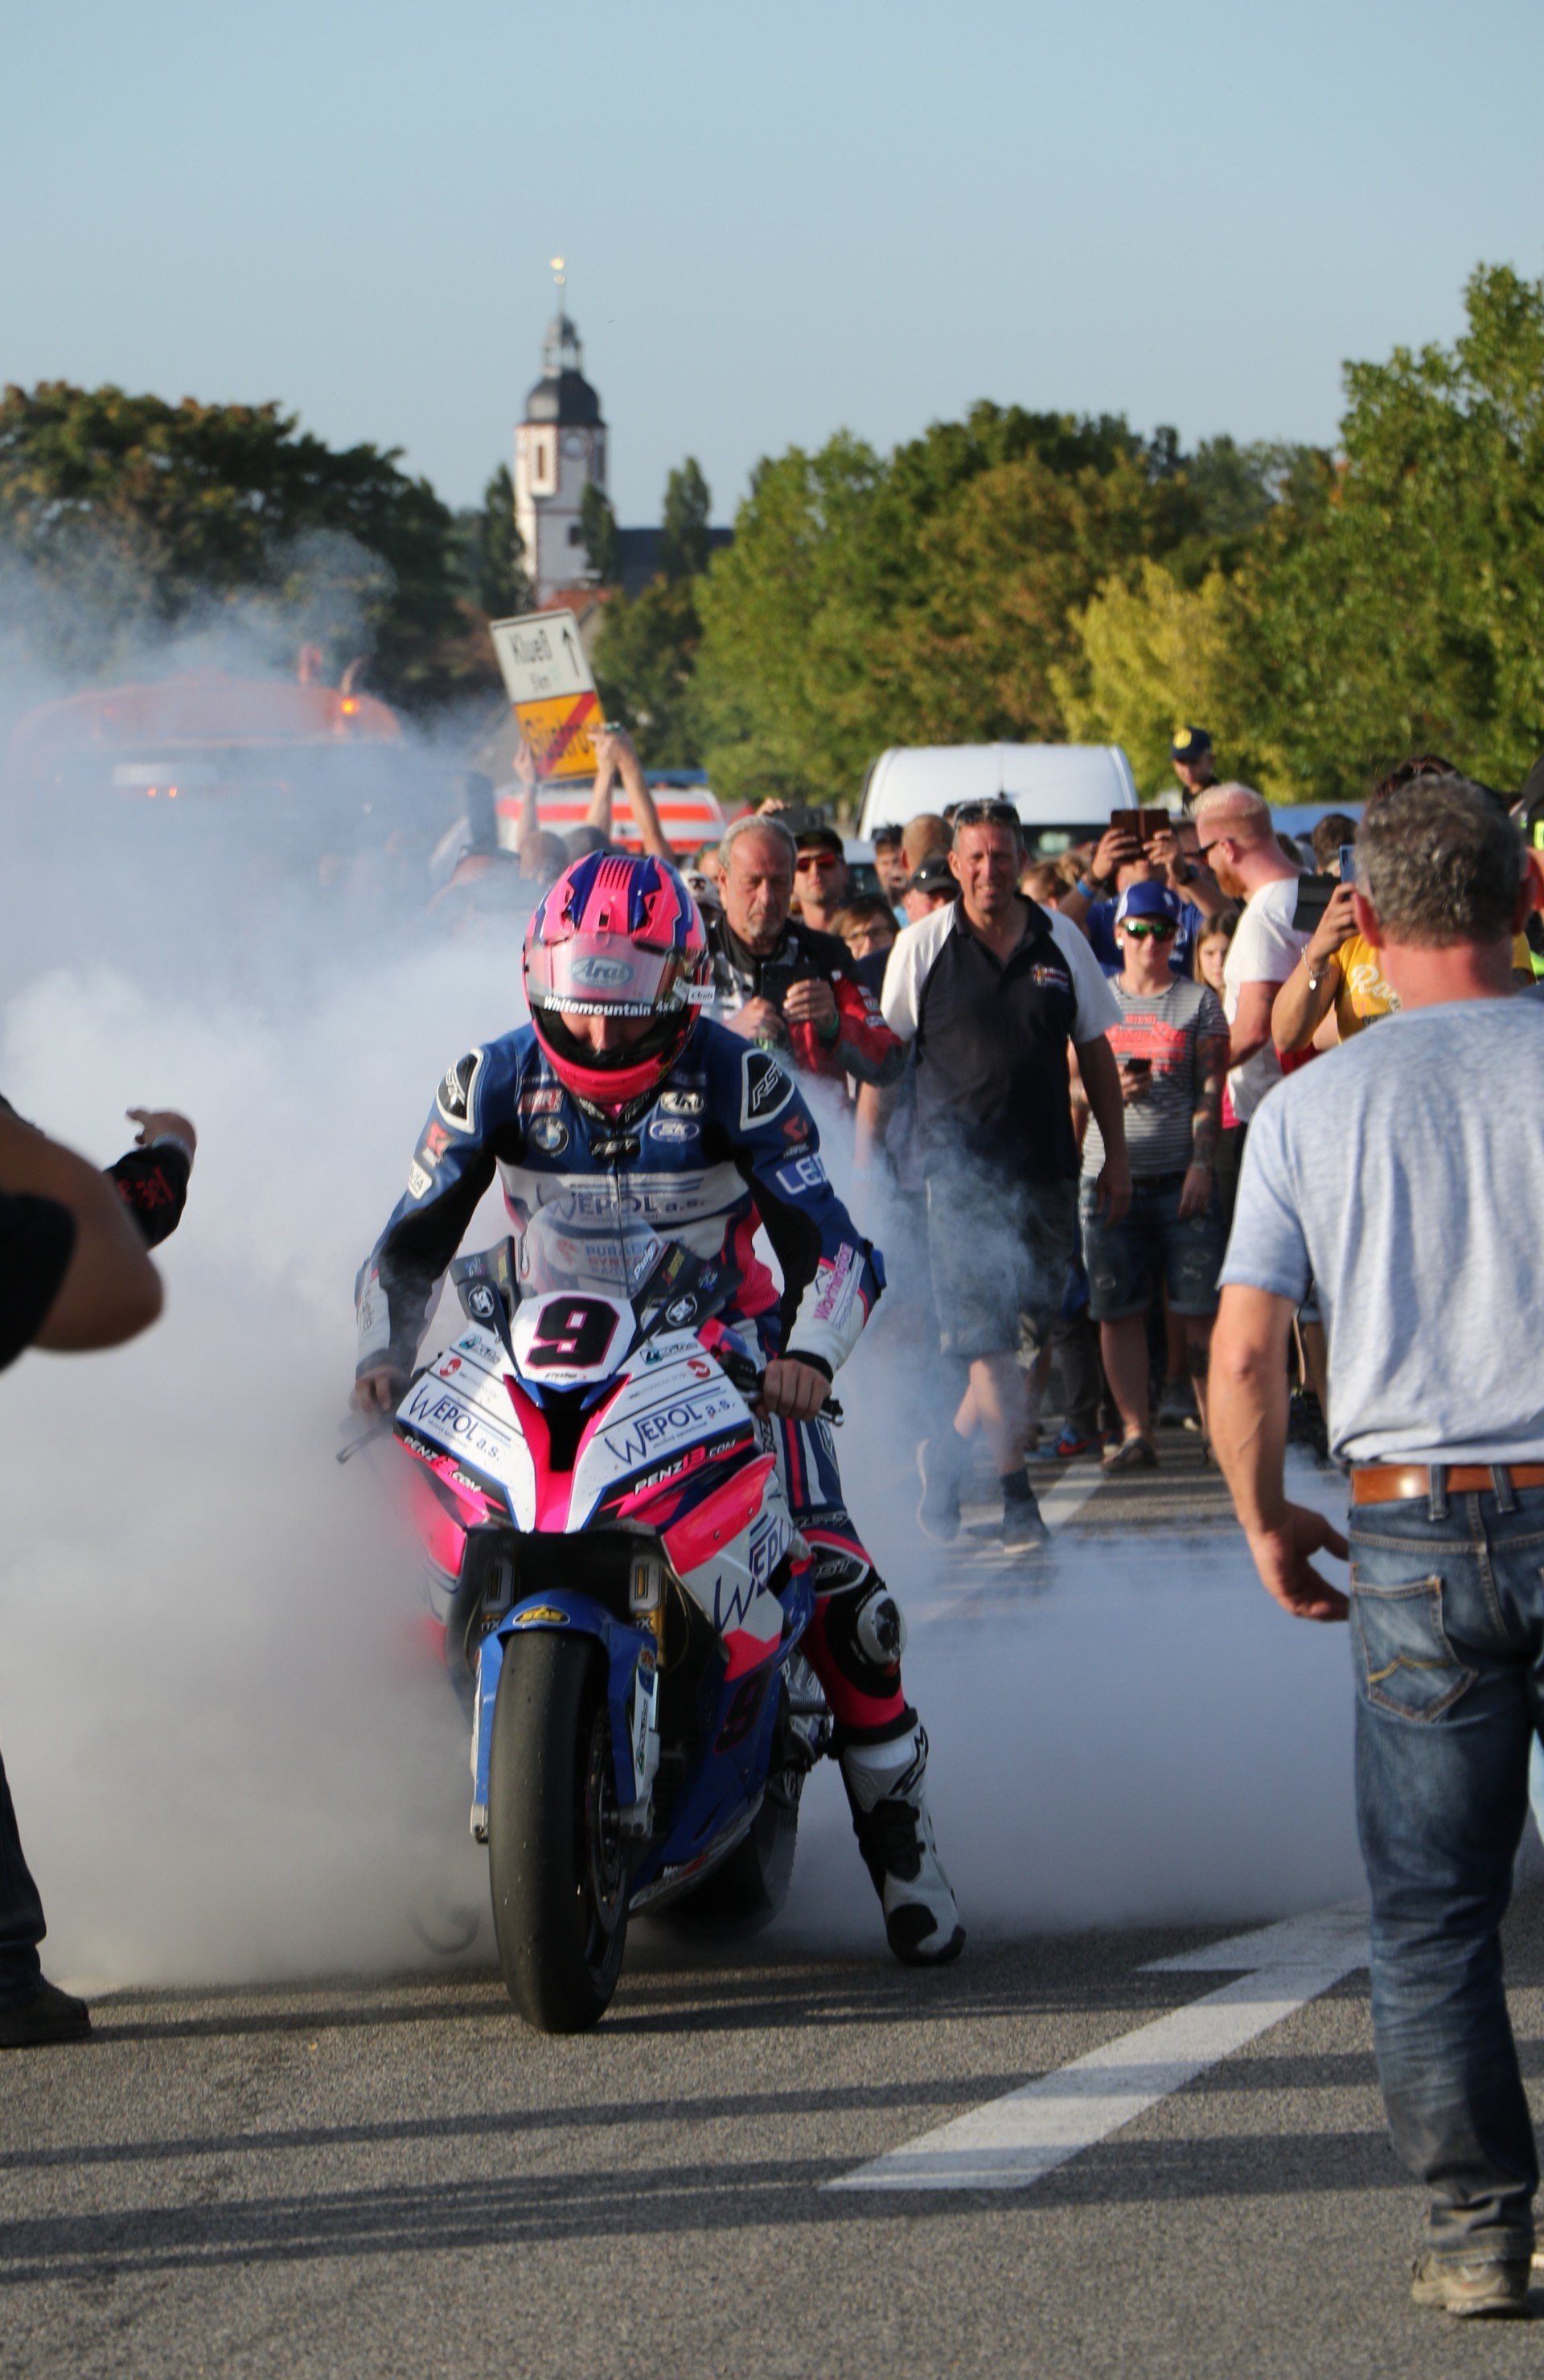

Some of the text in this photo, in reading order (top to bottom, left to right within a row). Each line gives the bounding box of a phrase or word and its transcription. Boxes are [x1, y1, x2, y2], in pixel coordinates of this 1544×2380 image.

[544, 994, 676, 1016] Whitemountain 4x4
[525, 1294, 621, 1369] 9
[409, 1383, 480, 1442] WEPOL
[475, 1437, 500, 1462] a.s.
[604, 1402, 704, 1465] WEPOL
[705, 1399, 737, 1416] a.s.
[634, 1438, 737, 1497] PENZ13.COM
